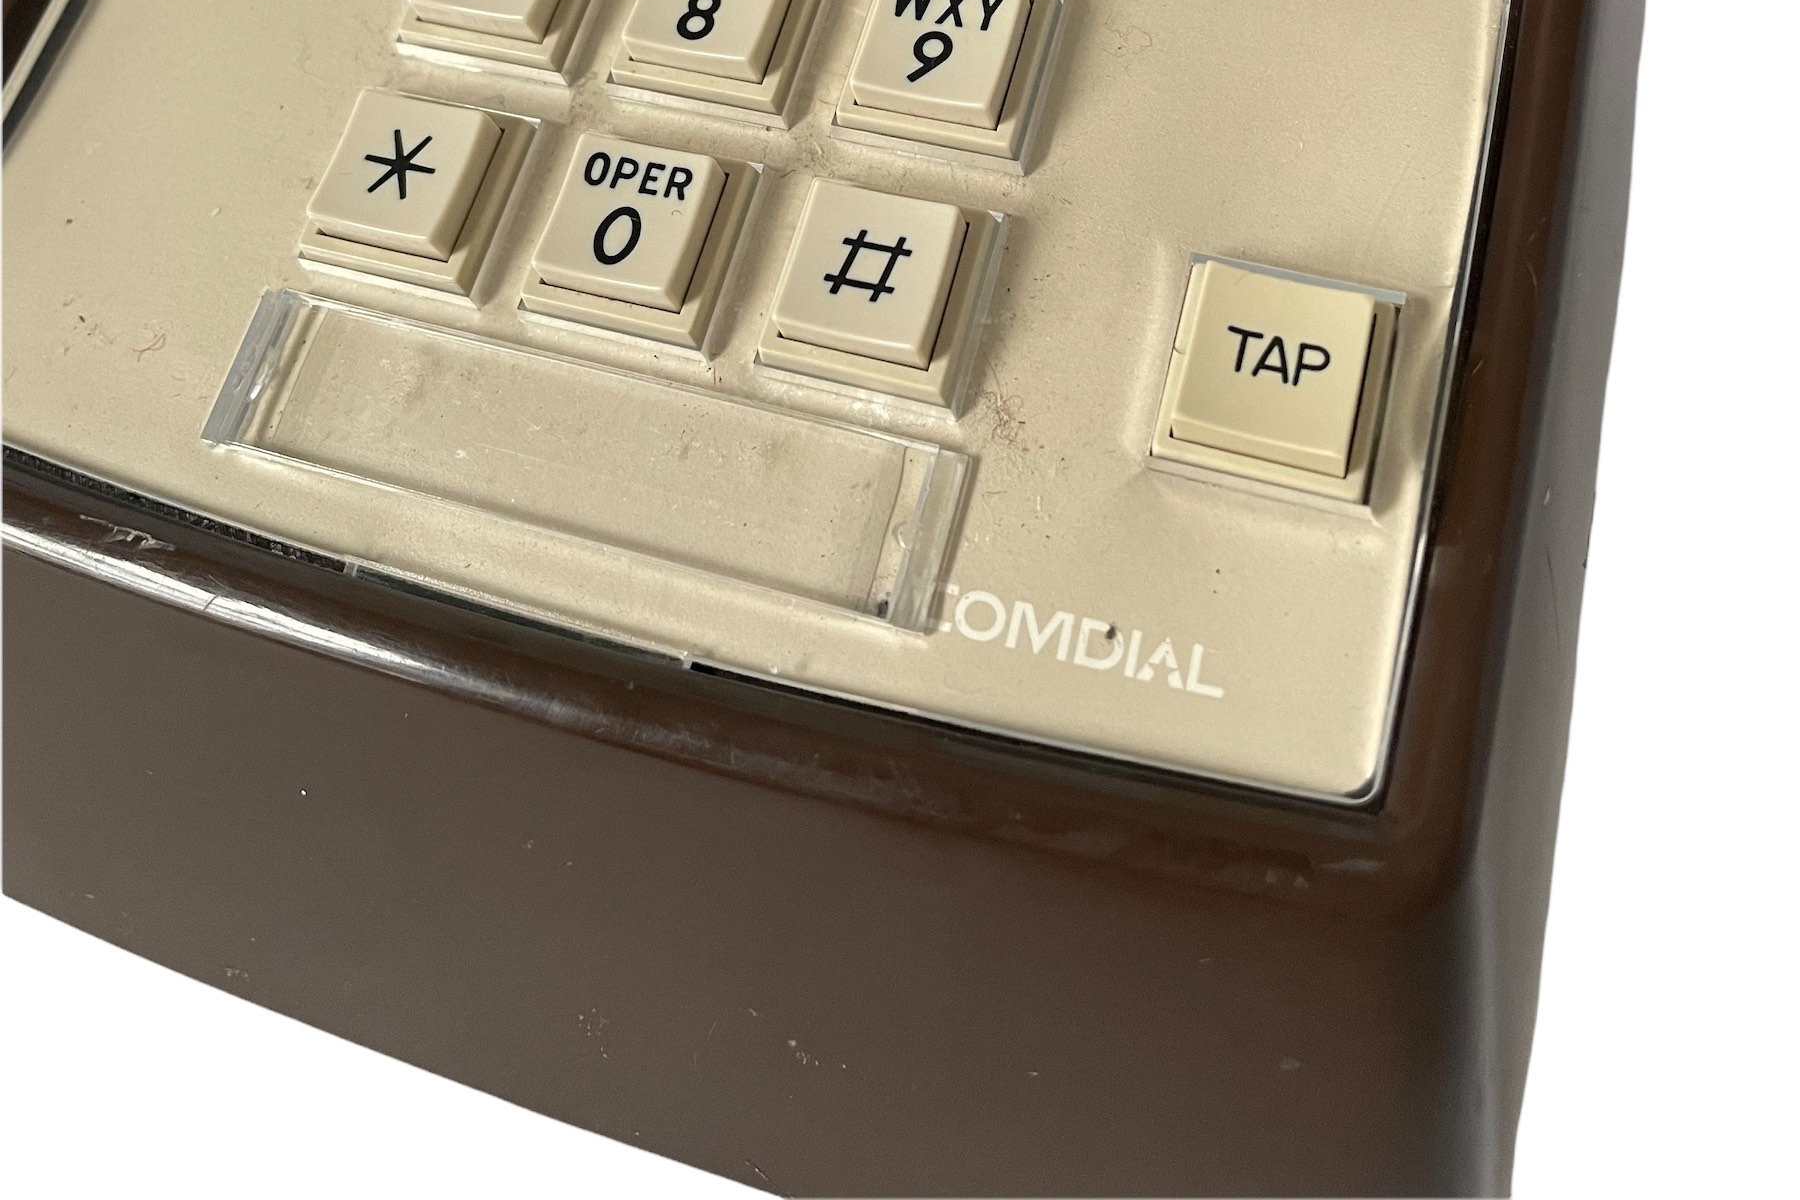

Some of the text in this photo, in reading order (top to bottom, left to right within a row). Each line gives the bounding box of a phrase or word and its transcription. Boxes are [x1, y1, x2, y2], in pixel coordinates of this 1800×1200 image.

[905, 29, 955, 84] 9
[583, 150, 694, 202] OPER
[1226, 324, 1332, 388] TAP
[938, 582, 1226, 700] OMDIAL
